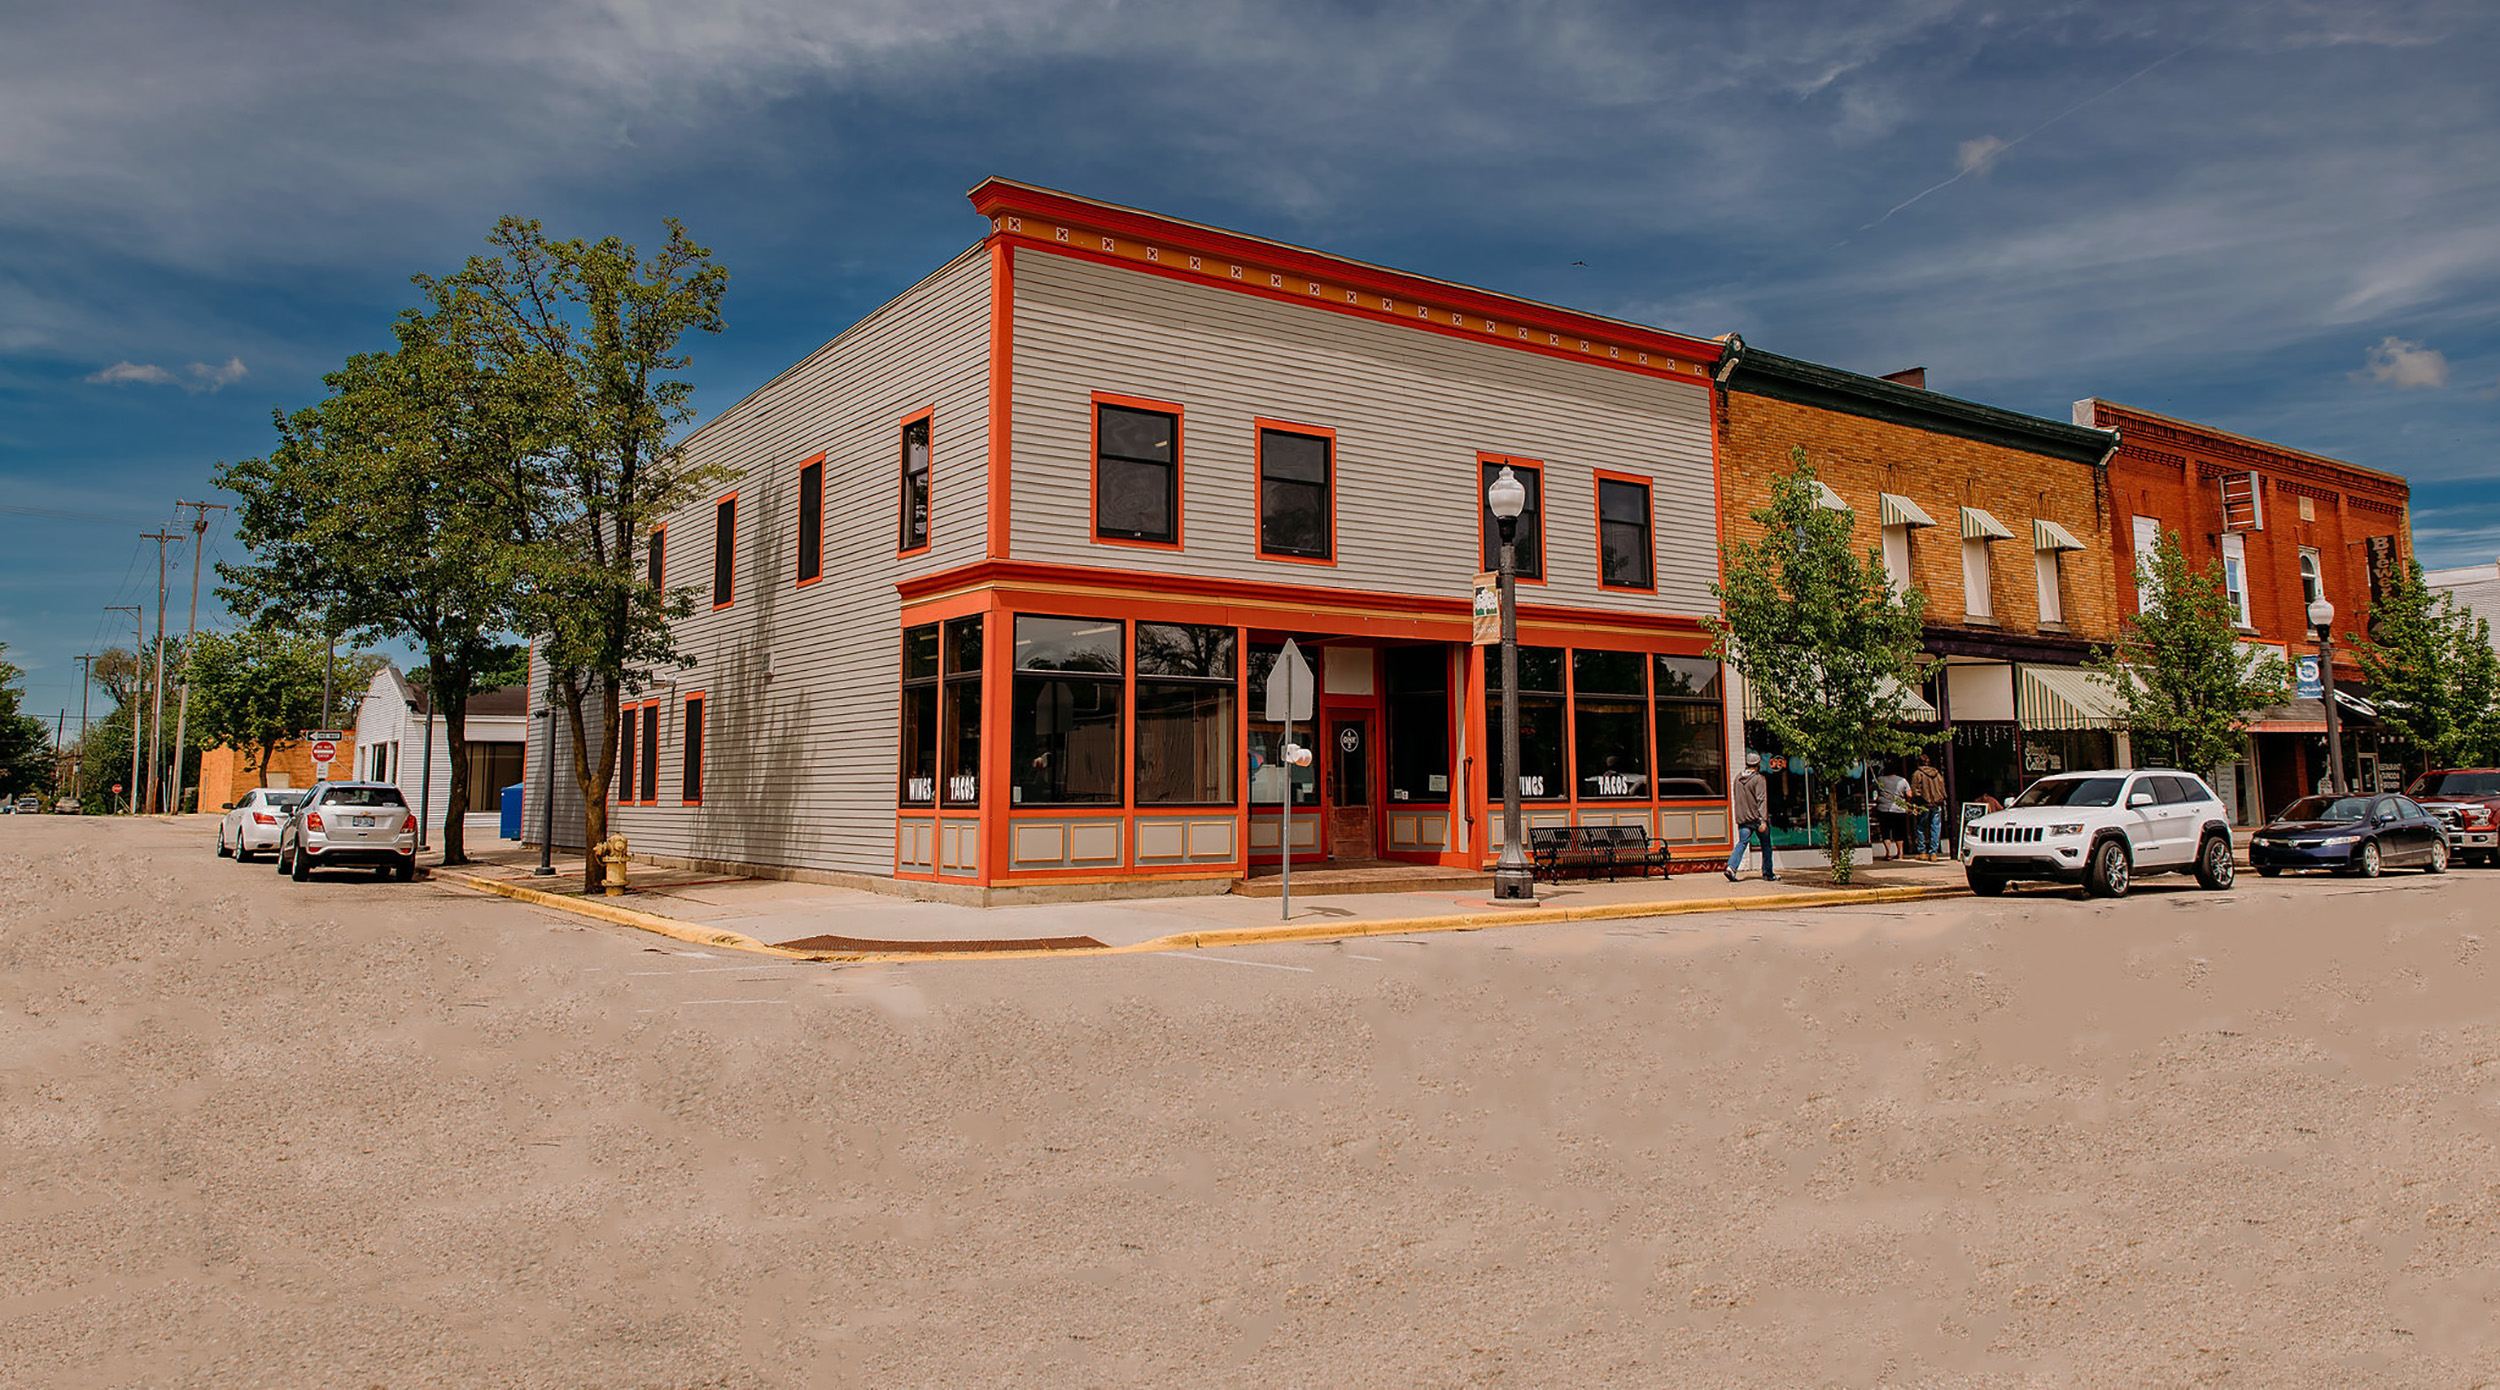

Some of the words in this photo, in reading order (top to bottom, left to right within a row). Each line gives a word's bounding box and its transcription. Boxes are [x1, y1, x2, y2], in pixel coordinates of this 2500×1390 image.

[2371, 536, 2393, 598] Brewer
[1769, 758, 1787, 769] OPEN
[908, 777, 932, 801] WINGS
[950, 776, 975, 801] TACOS
[1519, 776, 1544, 796] INGS
[1598, 775, 1628, 795] TACOS
